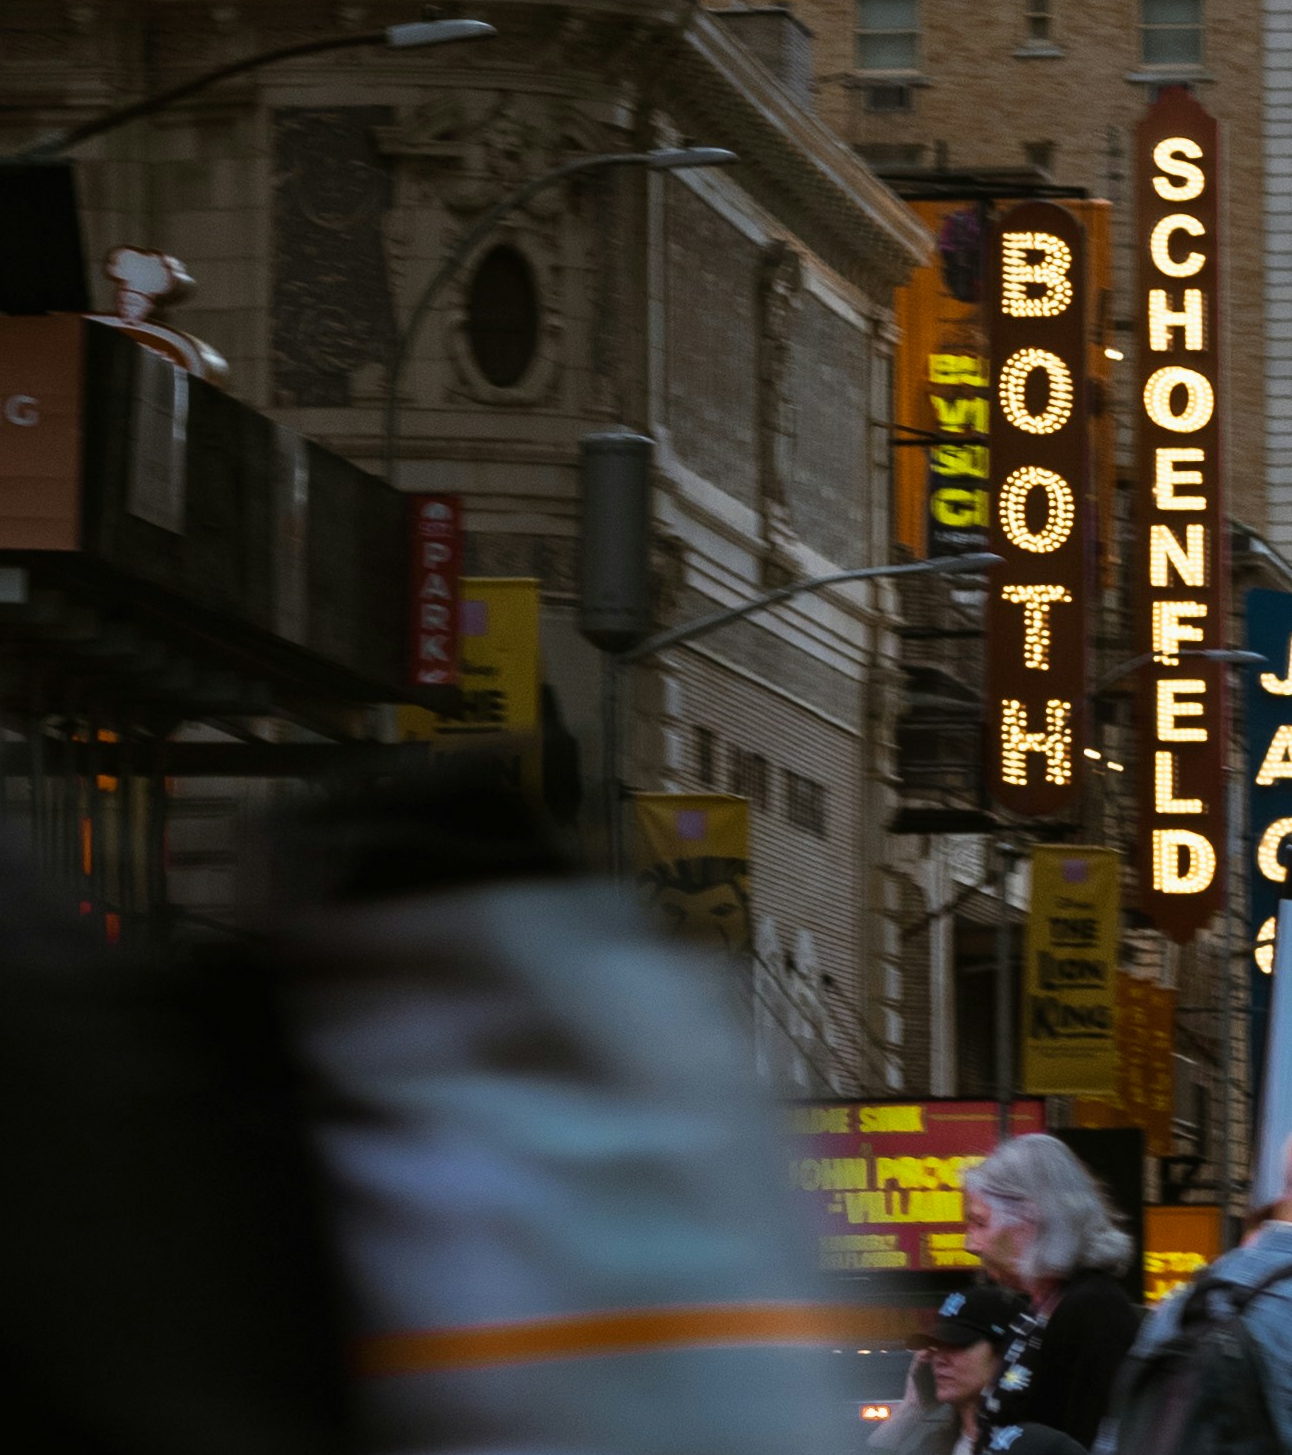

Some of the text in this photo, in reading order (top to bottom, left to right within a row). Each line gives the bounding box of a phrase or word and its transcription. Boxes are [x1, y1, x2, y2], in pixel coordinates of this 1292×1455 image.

[418, 541, 455, 663] PARK
[998, 230, 1076, 788] BOOTH
[1142, 136, 1218, 896] SCHOENFELD
